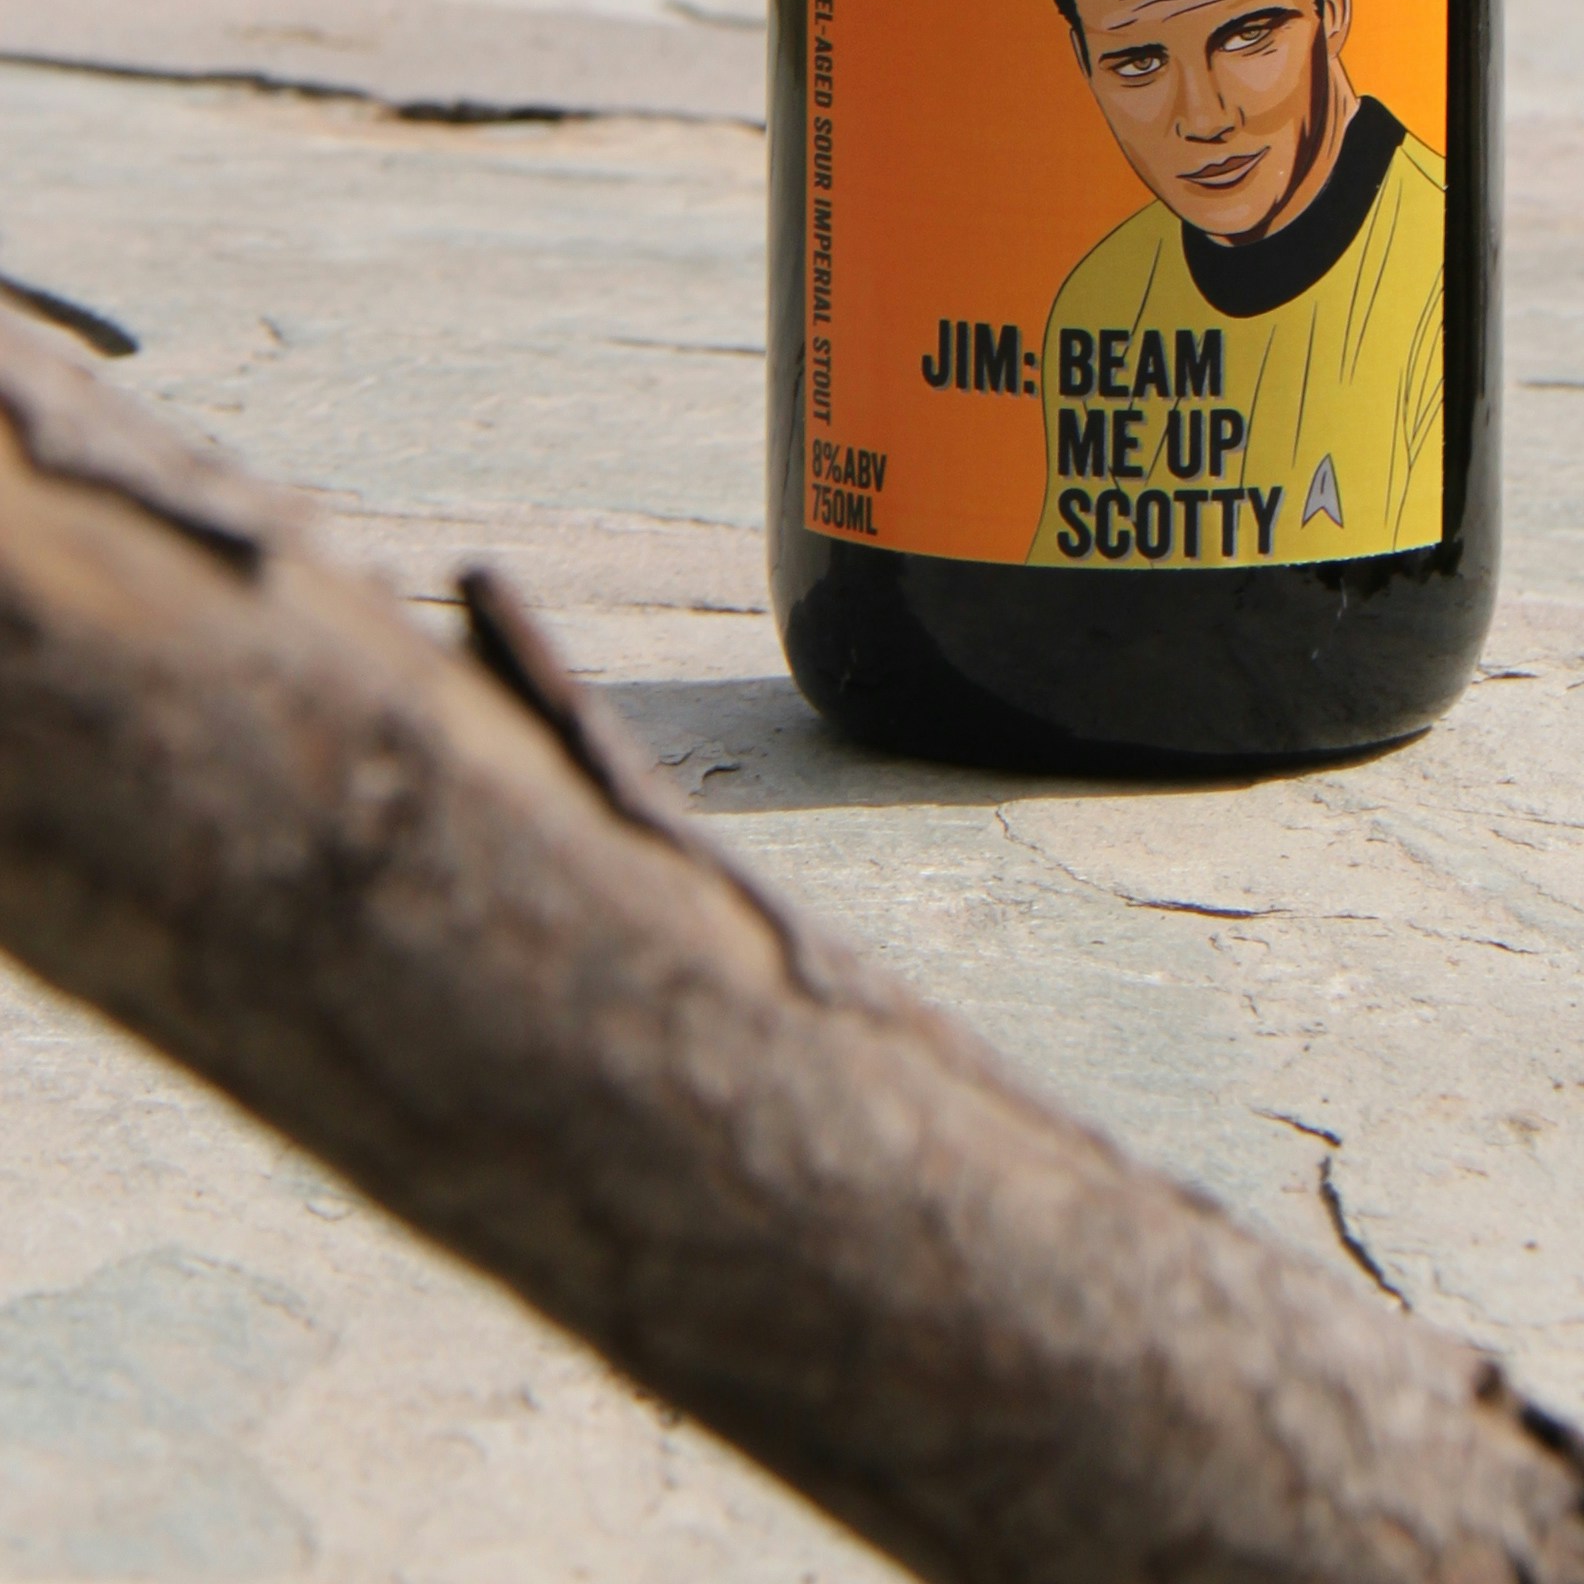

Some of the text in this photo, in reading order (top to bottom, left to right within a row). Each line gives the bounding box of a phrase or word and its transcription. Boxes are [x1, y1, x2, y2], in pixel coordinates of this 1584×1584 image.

[814, 116, 833, 190] SOUR
[813, 198, 832, 326] IMPERIAL
[813, 336, 832, 426] STOUT
[921, 319, 1224, 399] JIM: BEAM
[812, 438, 887, 492] 8%ABV
[1057, 408, 1246, 480] ME UP
[812, 483, 878, 536] 750ML
[1056, 485, 1285, 561] SCOTTY
